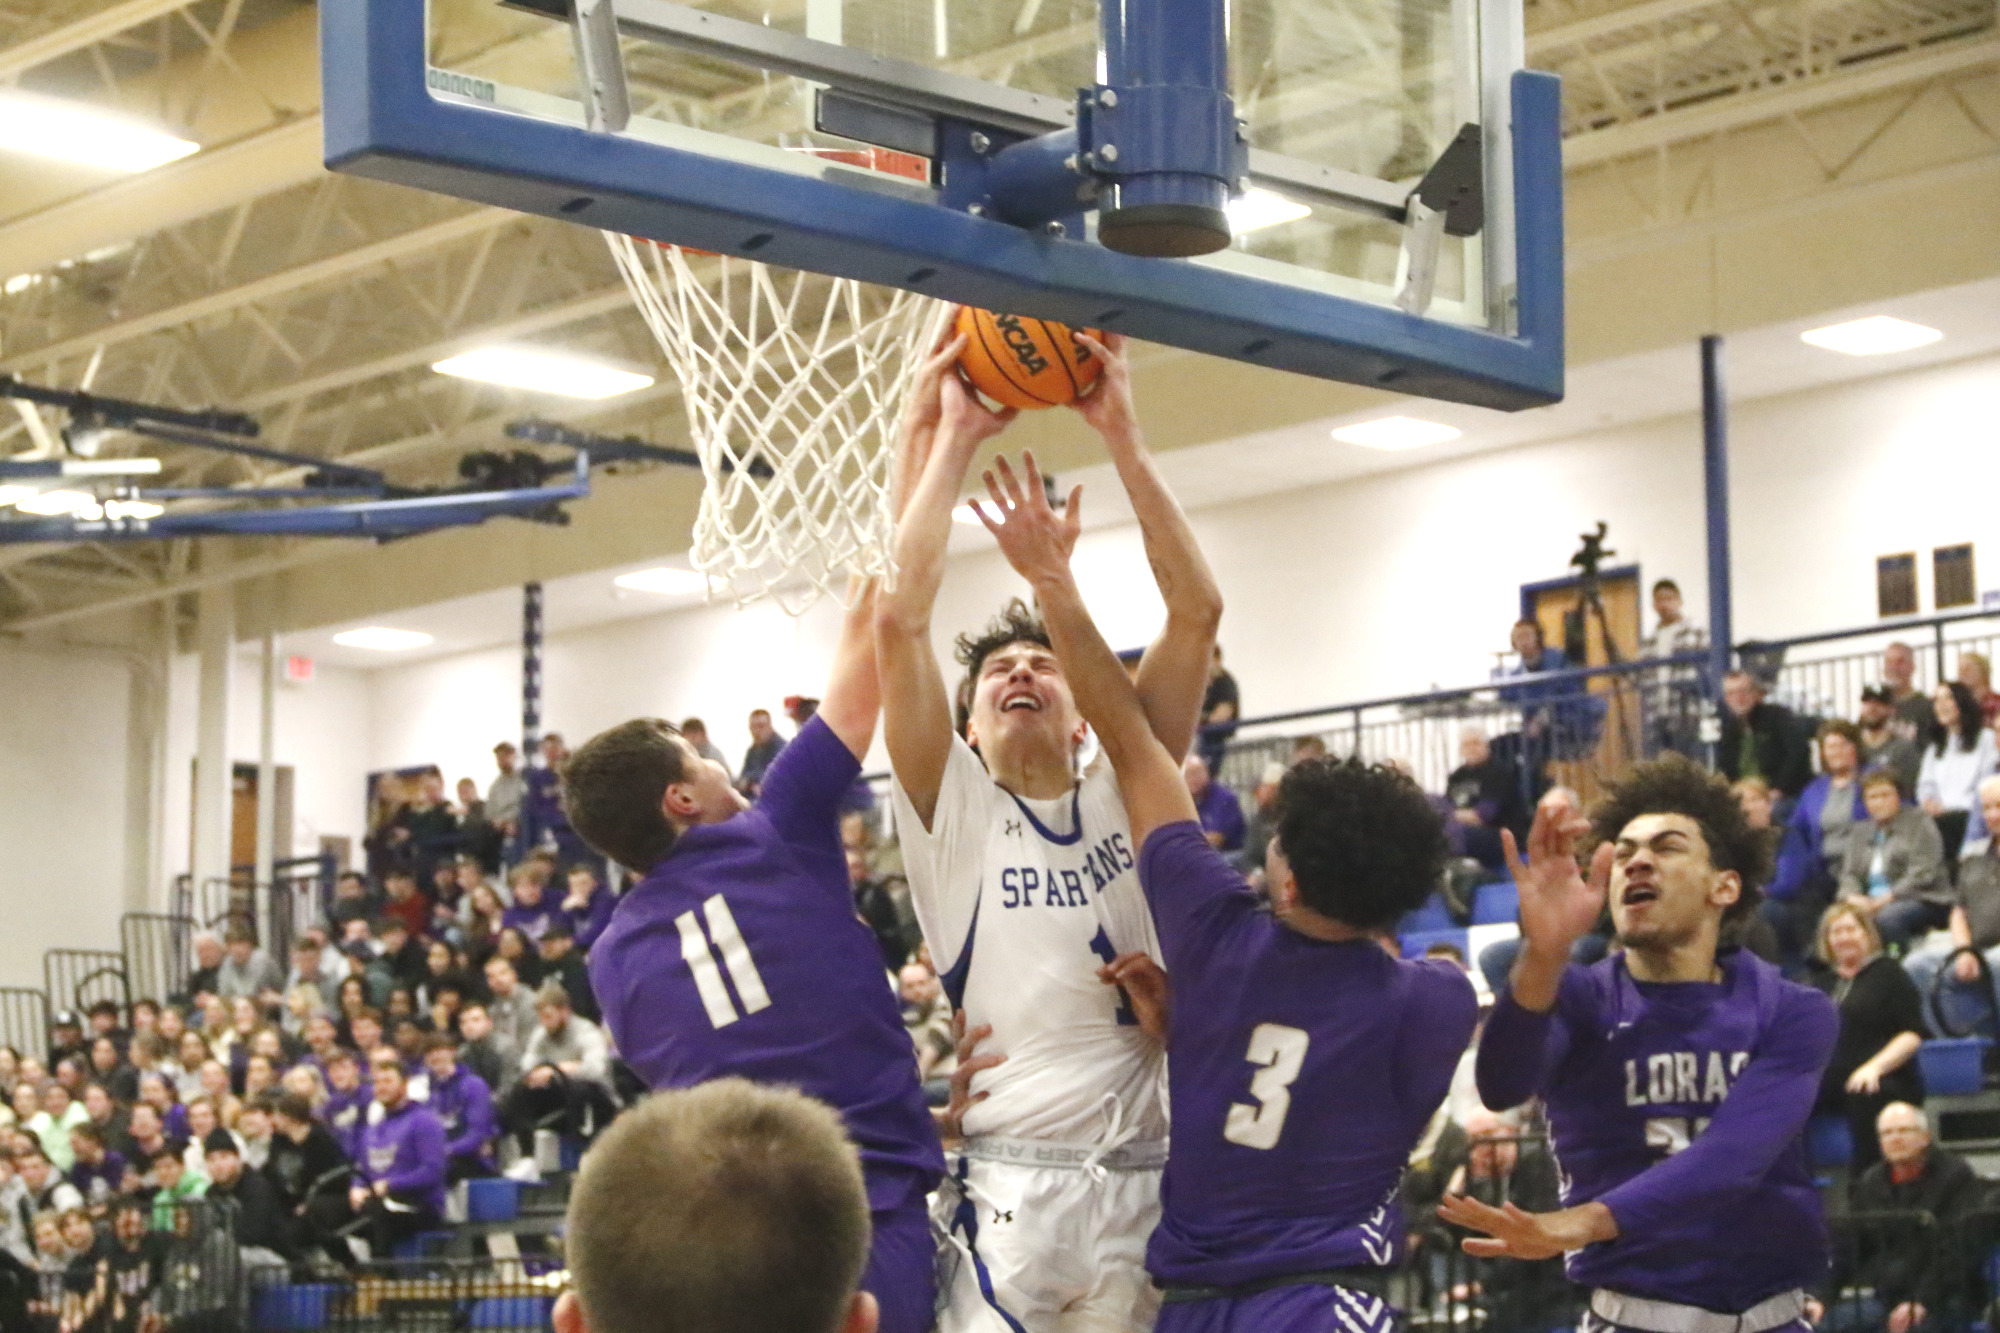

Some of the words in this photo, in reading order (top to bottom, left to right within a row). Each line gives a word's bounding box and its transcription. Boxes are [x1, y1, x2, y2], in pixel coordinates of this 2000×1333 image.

[1001, 832, 1133, 908] SPARANS
[674, 893, 772, 1029] 11
[1224, 1023, 1310, 1150] 3
